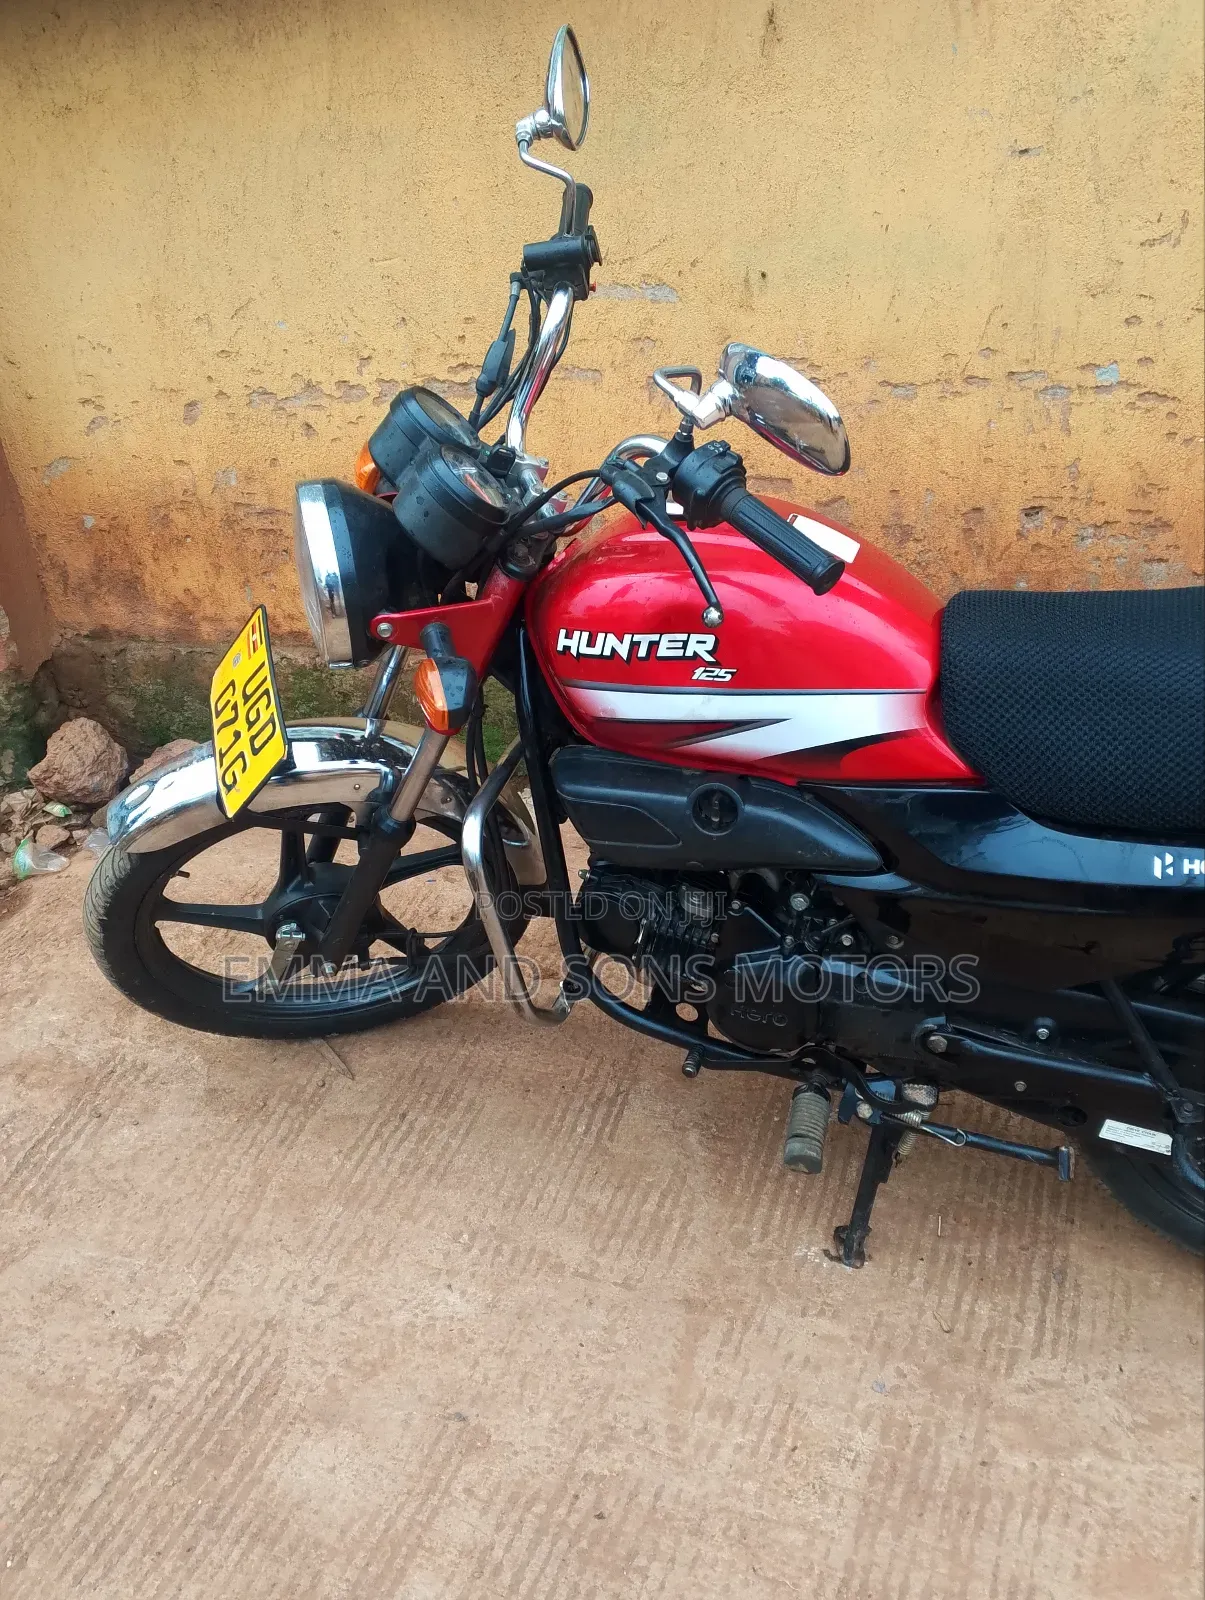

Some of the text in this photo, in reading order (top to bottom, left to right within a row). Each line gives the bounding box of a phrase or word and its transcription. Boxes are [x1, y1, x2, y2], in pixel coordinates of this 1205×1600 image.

[556, 628, 720, 664] HUNTER
[690, 666, 738, 682] 125
[214, 679, 247, 795] 071G
[242, 661, 277, 757] UGD
